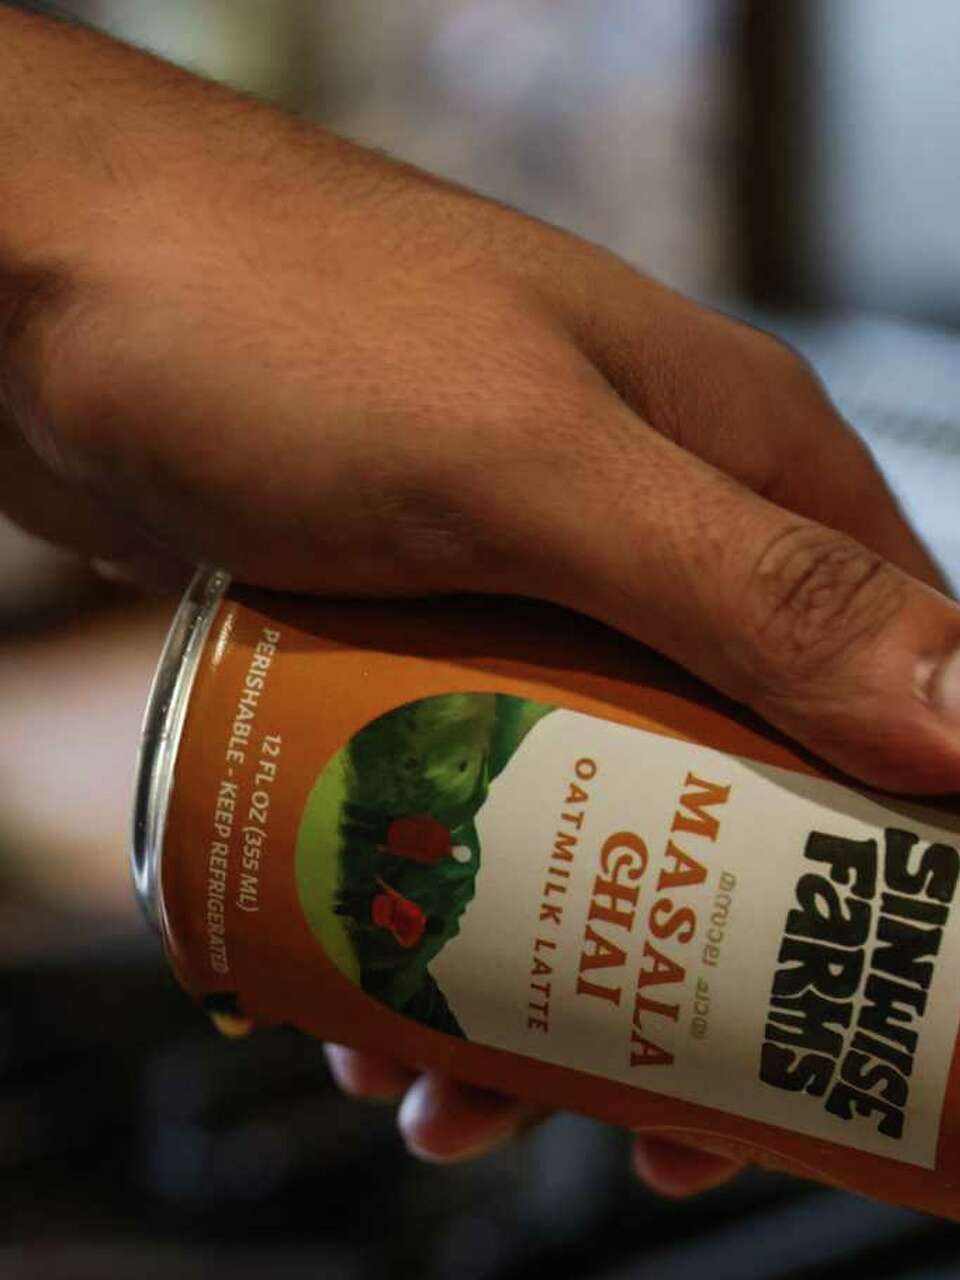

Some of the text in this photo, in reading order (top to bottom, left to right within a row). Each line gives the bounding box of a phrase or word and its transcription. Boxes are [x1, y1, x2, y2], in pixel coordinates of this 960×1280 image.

[225, 628, 280, 764] PERISHABLE
[214, 780, 237, 838] KEEP
[235, 734, 282, 912] 12 FL OZ (355 ML)
[528, 757, 597, 1033] OATMILK LATTE
[207, 841, 230, 975] REFRIGERATED
[576, 831, 649, 1007] CHAI
[630, 771, 732, 1068] MASALA
